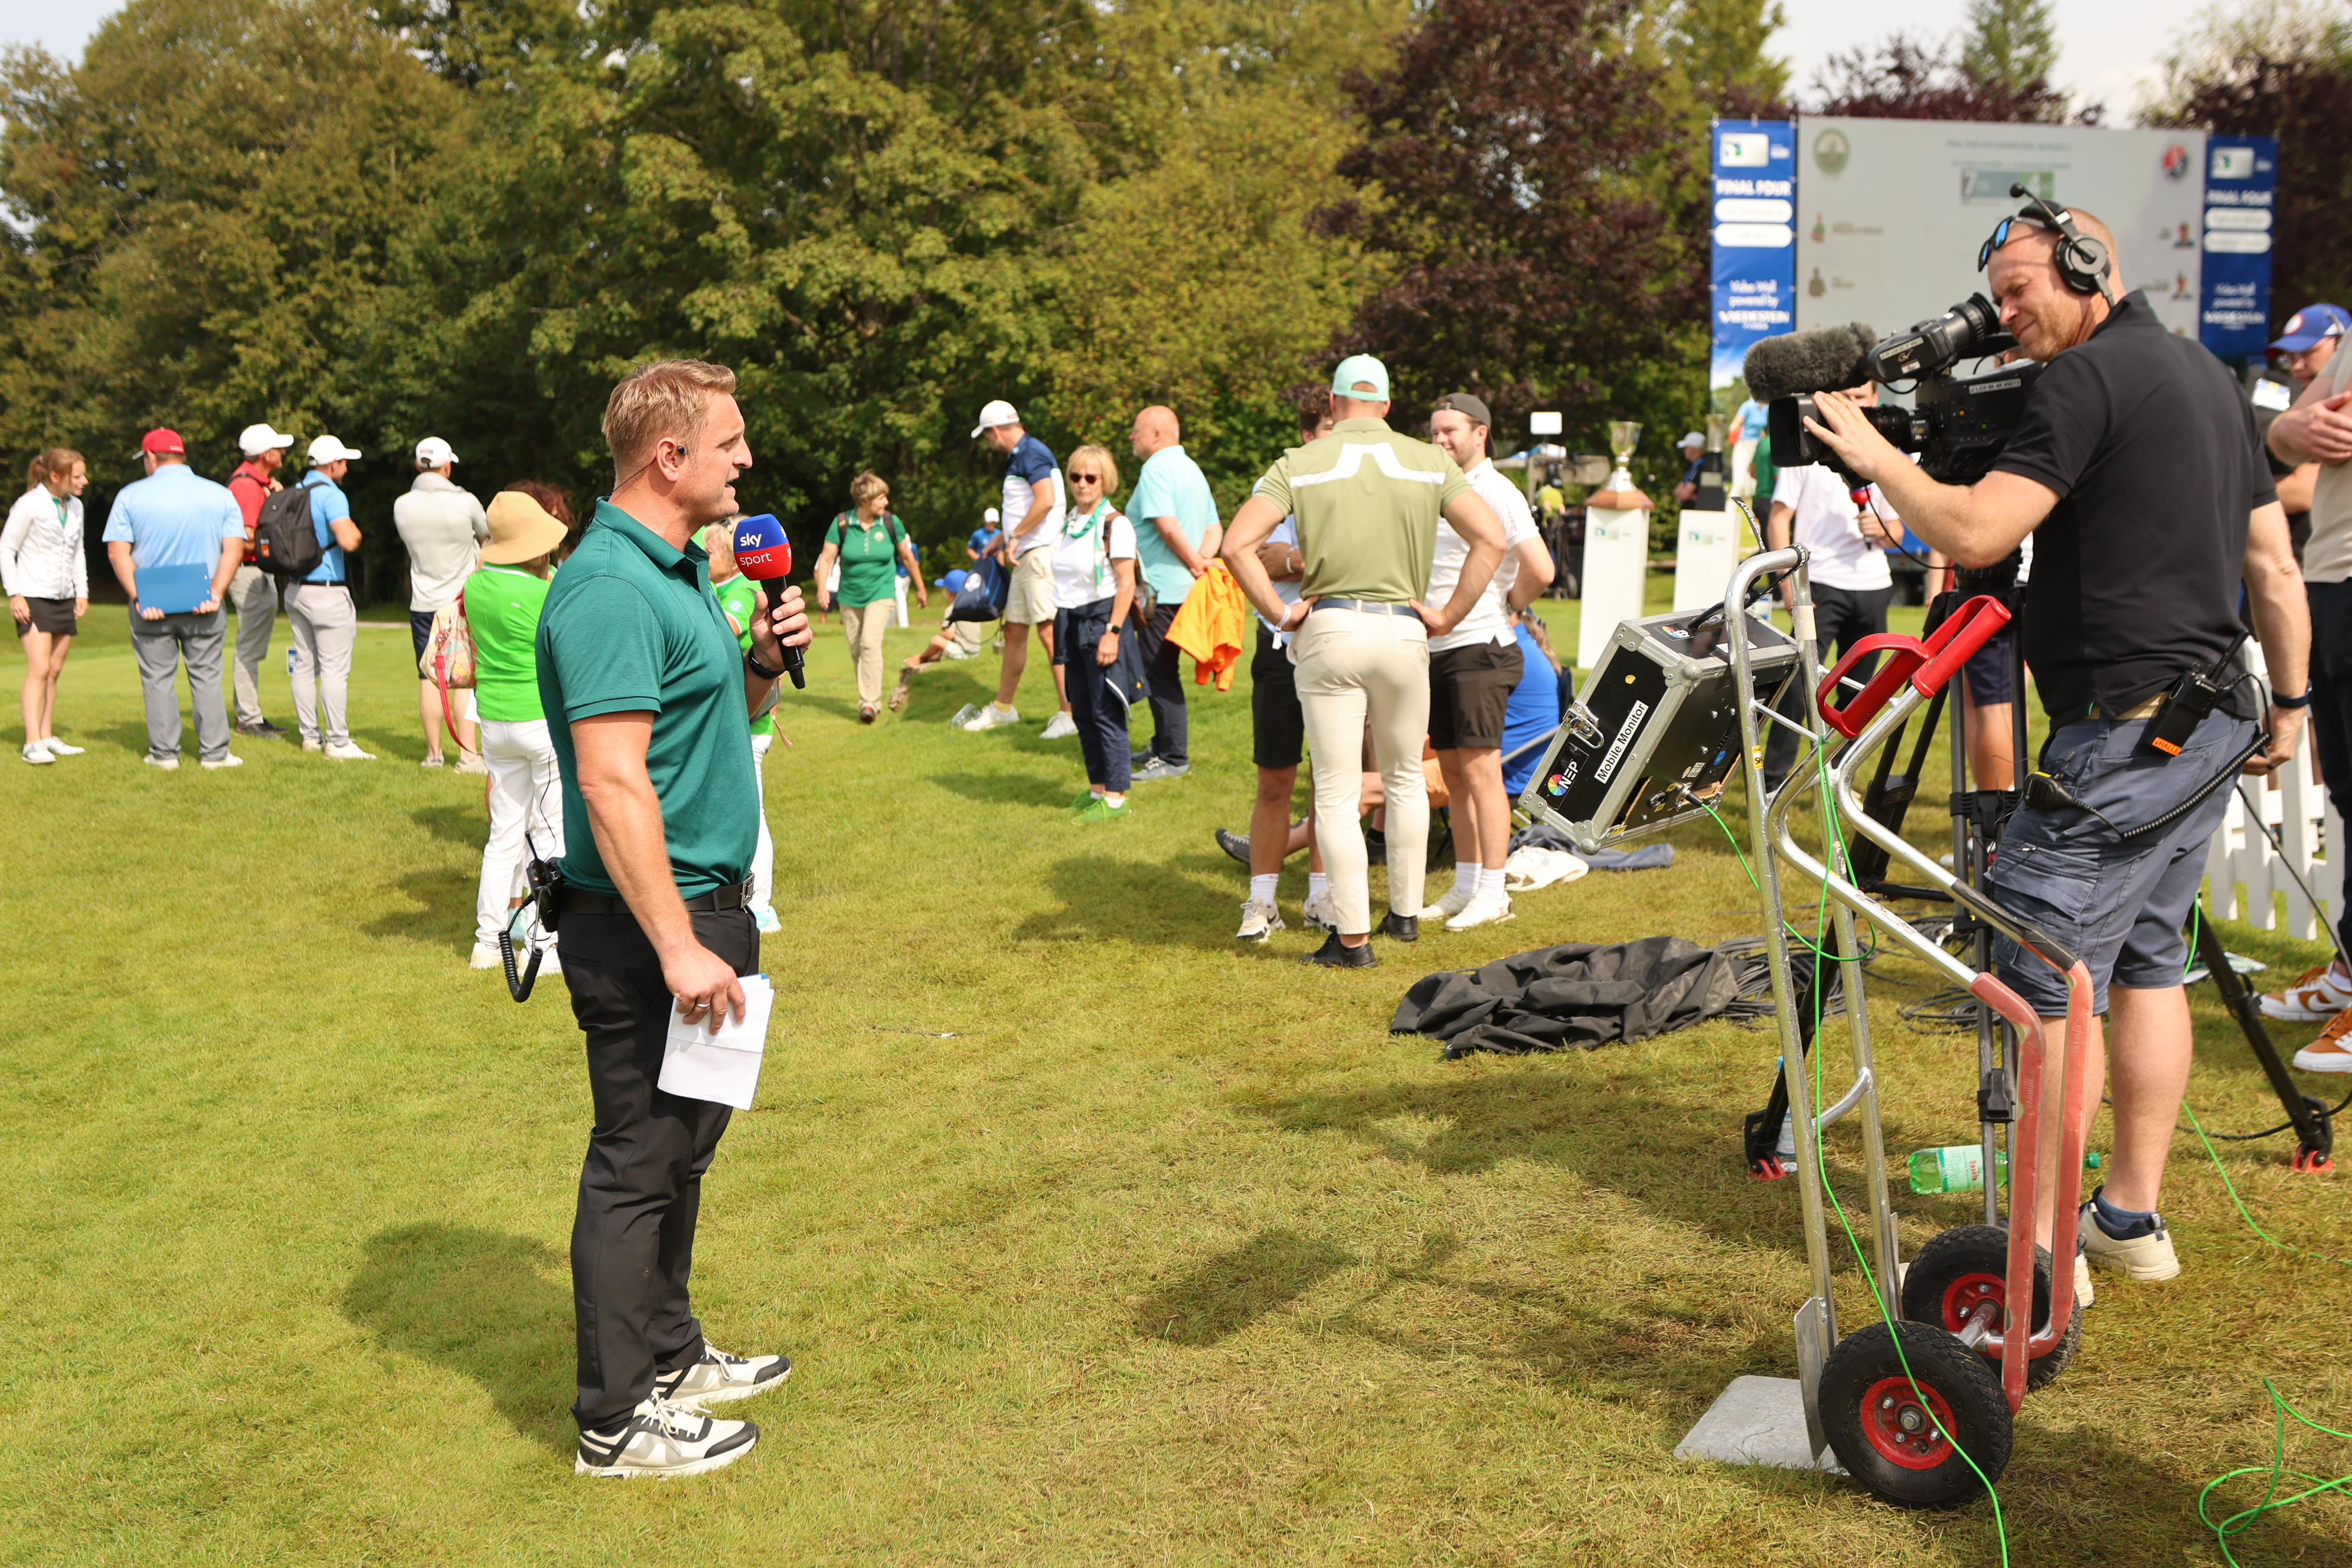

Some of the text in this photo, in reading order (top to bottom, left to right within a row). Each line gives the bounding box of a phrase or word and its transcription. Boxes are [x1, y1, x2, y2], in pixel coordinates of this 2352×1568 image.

[1716, 179, 1792, 196] FINAL FOUR
[1729, 279, 1756, 294] Video
[740, 533, 762, 547] sky
[740, 552, 773, 567] sport
[1597, 704, 1645, 781] Mobile Monitor
[1558, 760, 1579, 789] NEP
[1969, 1160, 1979, 1181] Saskia
